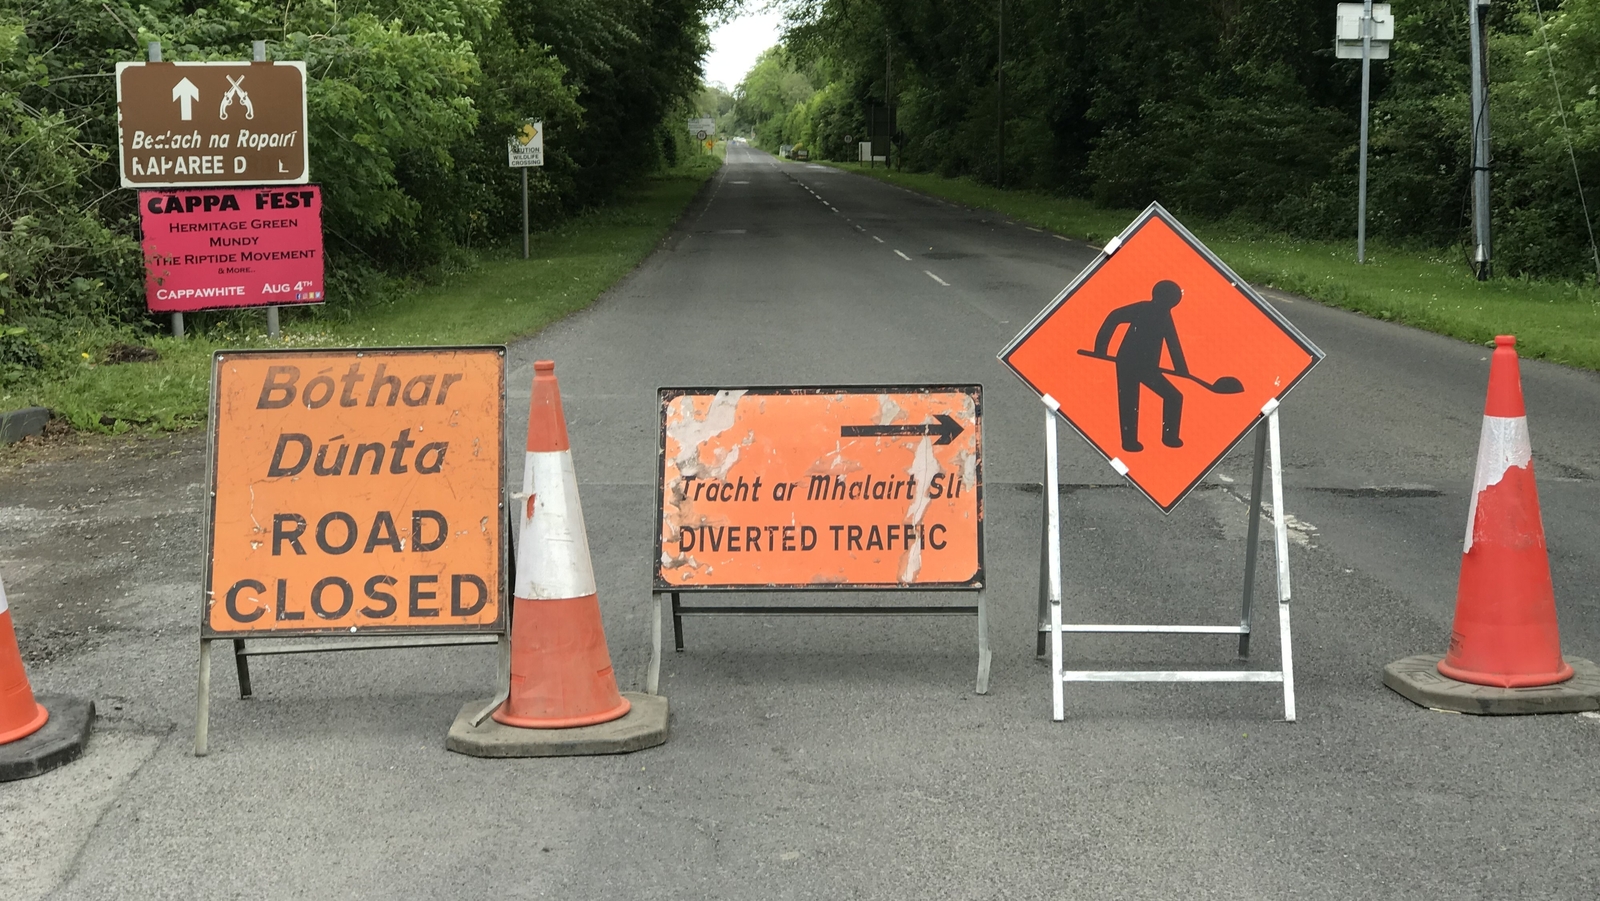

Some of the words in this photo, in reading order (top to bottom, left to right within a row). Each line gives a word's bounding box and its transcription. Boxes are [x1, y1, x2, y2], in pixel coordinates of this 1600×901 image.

[209, 133, 230, 149] na
[147, 194, 240, 215] CAPPA
[255, 190, 314, 210] FEST
[169, 220, 248, 233] HERMITAGE
[250, 218, 298, 230] GREEN
[209, 236, 259, 248] MUNDY
[153, 254, 181, 266] THE
[184, 253, 237, 265] RIPTIDE
[240, 249, 316, 262] MOVEMENT
[217, 267, 225, 275] &
[156, 285, 246, 301] CAPPAWHITE
[261, 283, 291, 295] AUG
[293, 280, 313, 293] 4TH
[256, 362, 463, 411] Bóthar
[266, 428, 449, 478] Dúnta
[772, 482, 798, 501] ar
[806, 474, 917, 501] Mhalairt
[271, 510, 449, 556] ROAD
[679, 524, 818, 553] DIVERTED
[829, 523, 948, 551] TRAFFIC
[224, 574, 488, 623] CLOSED
